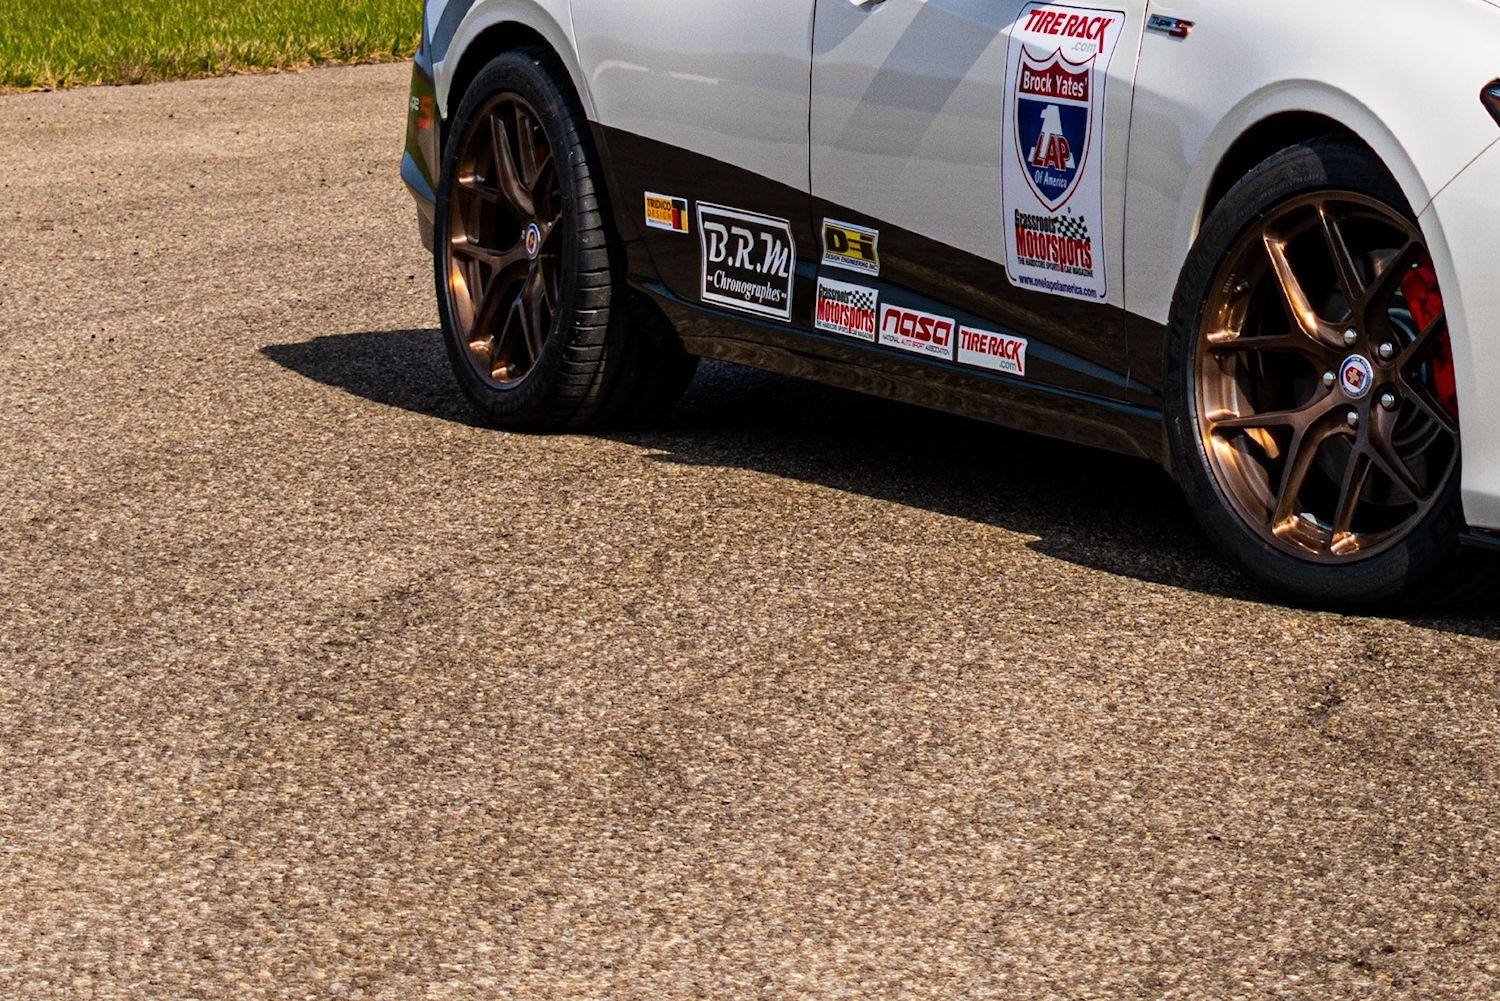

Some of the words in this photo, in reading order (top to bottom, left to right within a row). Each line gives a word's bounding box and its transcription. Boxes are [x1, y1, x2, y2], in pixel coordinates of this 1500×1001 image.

[1024, 9, 1067, 35] TIRE
[1060, 14, 1114, 53] RACK
[1072, 42, 1097, 53] .com
[1023, 70, 1052, 93] Brock
[1056, 75, 1088, 97] Yates'
[1031, 132, 1071, 172] LAP
[1034, 170, 1044, 184] Of
[1043, 171, 1068, 189] America
[1015, 226, 1092, 273] Motorsports
[713, 269, 781, 303] Chronographes
[817, 296, 874, 334] Motorsports
[882, 308, 952, 347] nasa
[960, 329, 988, 354] TIRE
[988, 335, 1023, 373] RACK
[1000, 360, 1017, 371] .com
